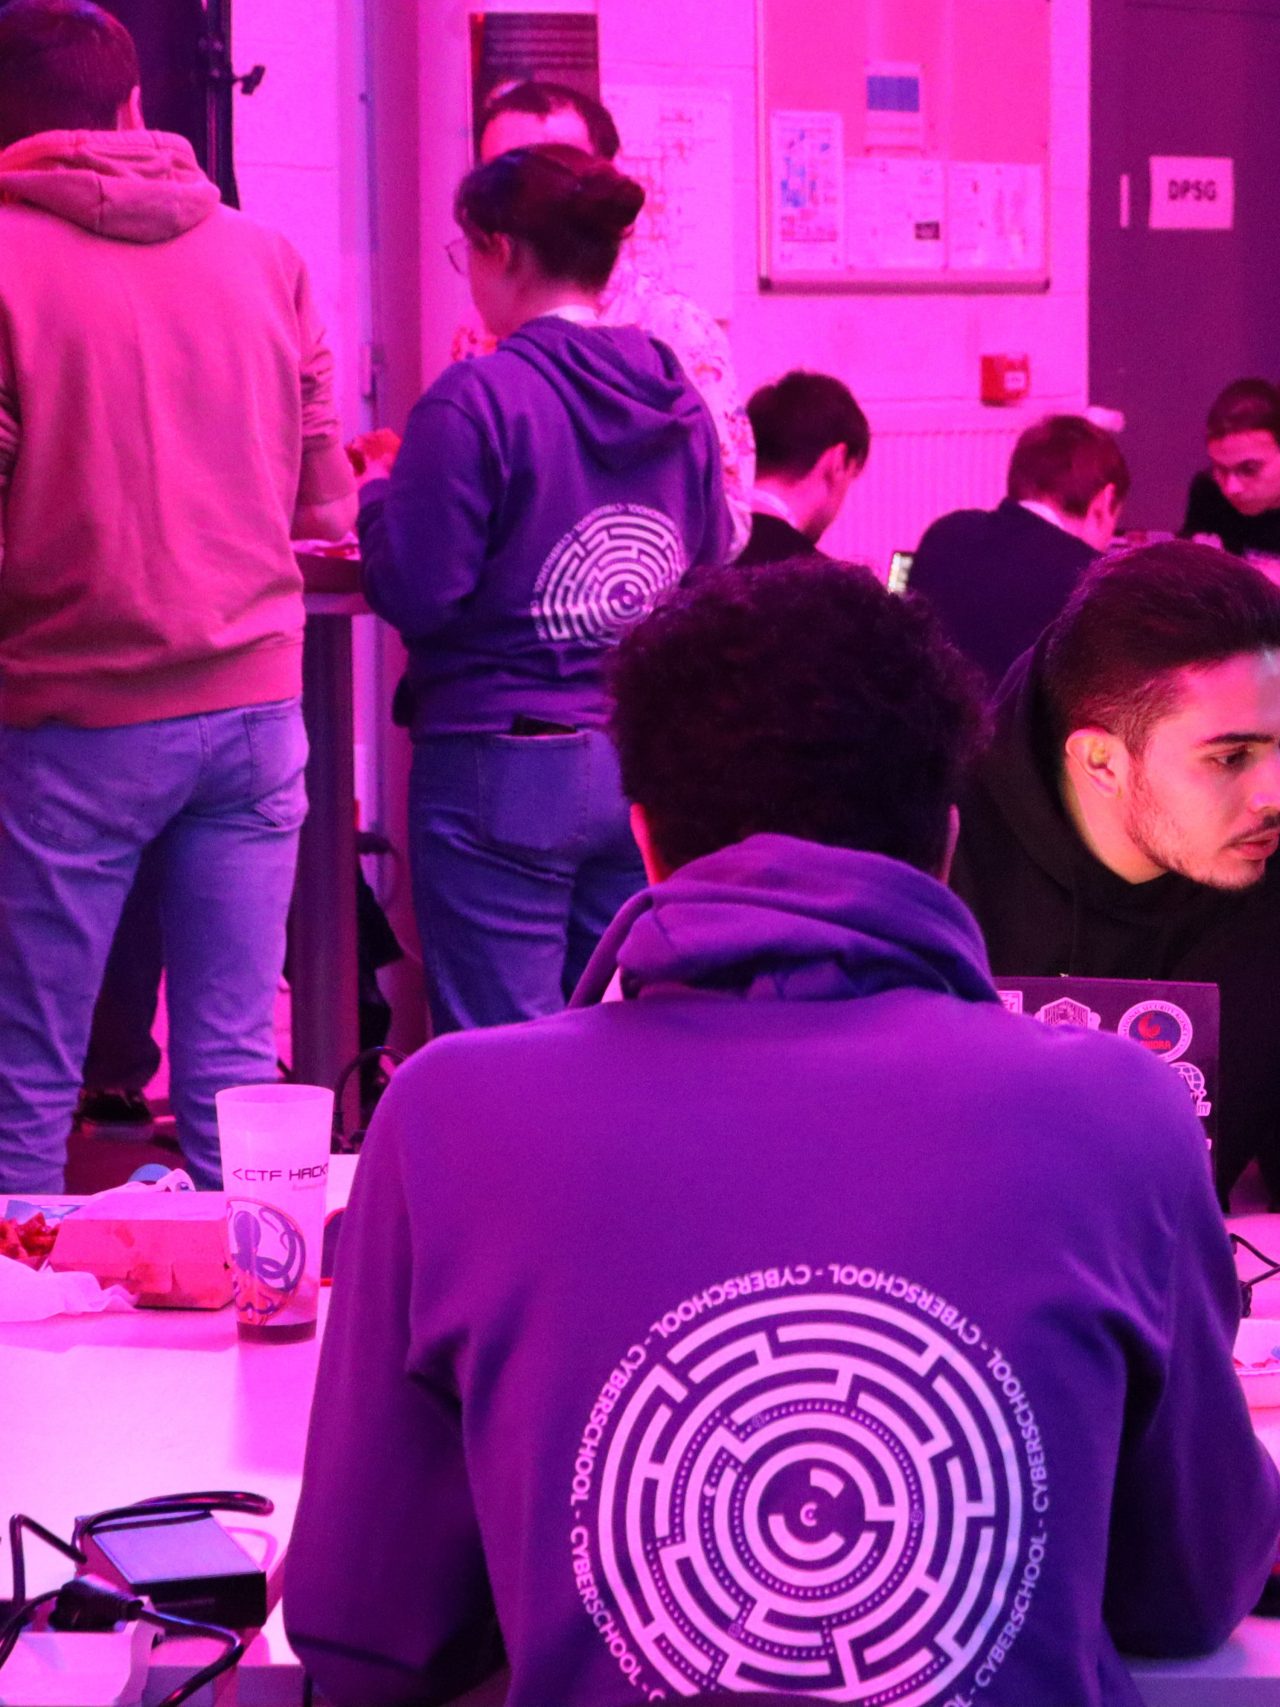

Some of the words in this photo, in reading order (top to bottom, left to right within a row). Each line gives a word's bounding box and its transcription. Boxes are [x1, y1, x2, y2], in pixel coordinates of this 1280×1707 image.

[1168, 180, 1217, 201] DPSG
[650, 1264, 811, 1337] CYBERSCHOOL
[826, 1263, 982, 1346] CYBERSCHOOL
[571, 1344, 647, 1506] CYBERSCHOOL
[986, 1348, 1049, 1512] CYBERSCHOOL
[570, 1528, 642, 1686] CYBERSCHOOL
[973, 1531, 1047, 1689] CYBERSCHOOL
